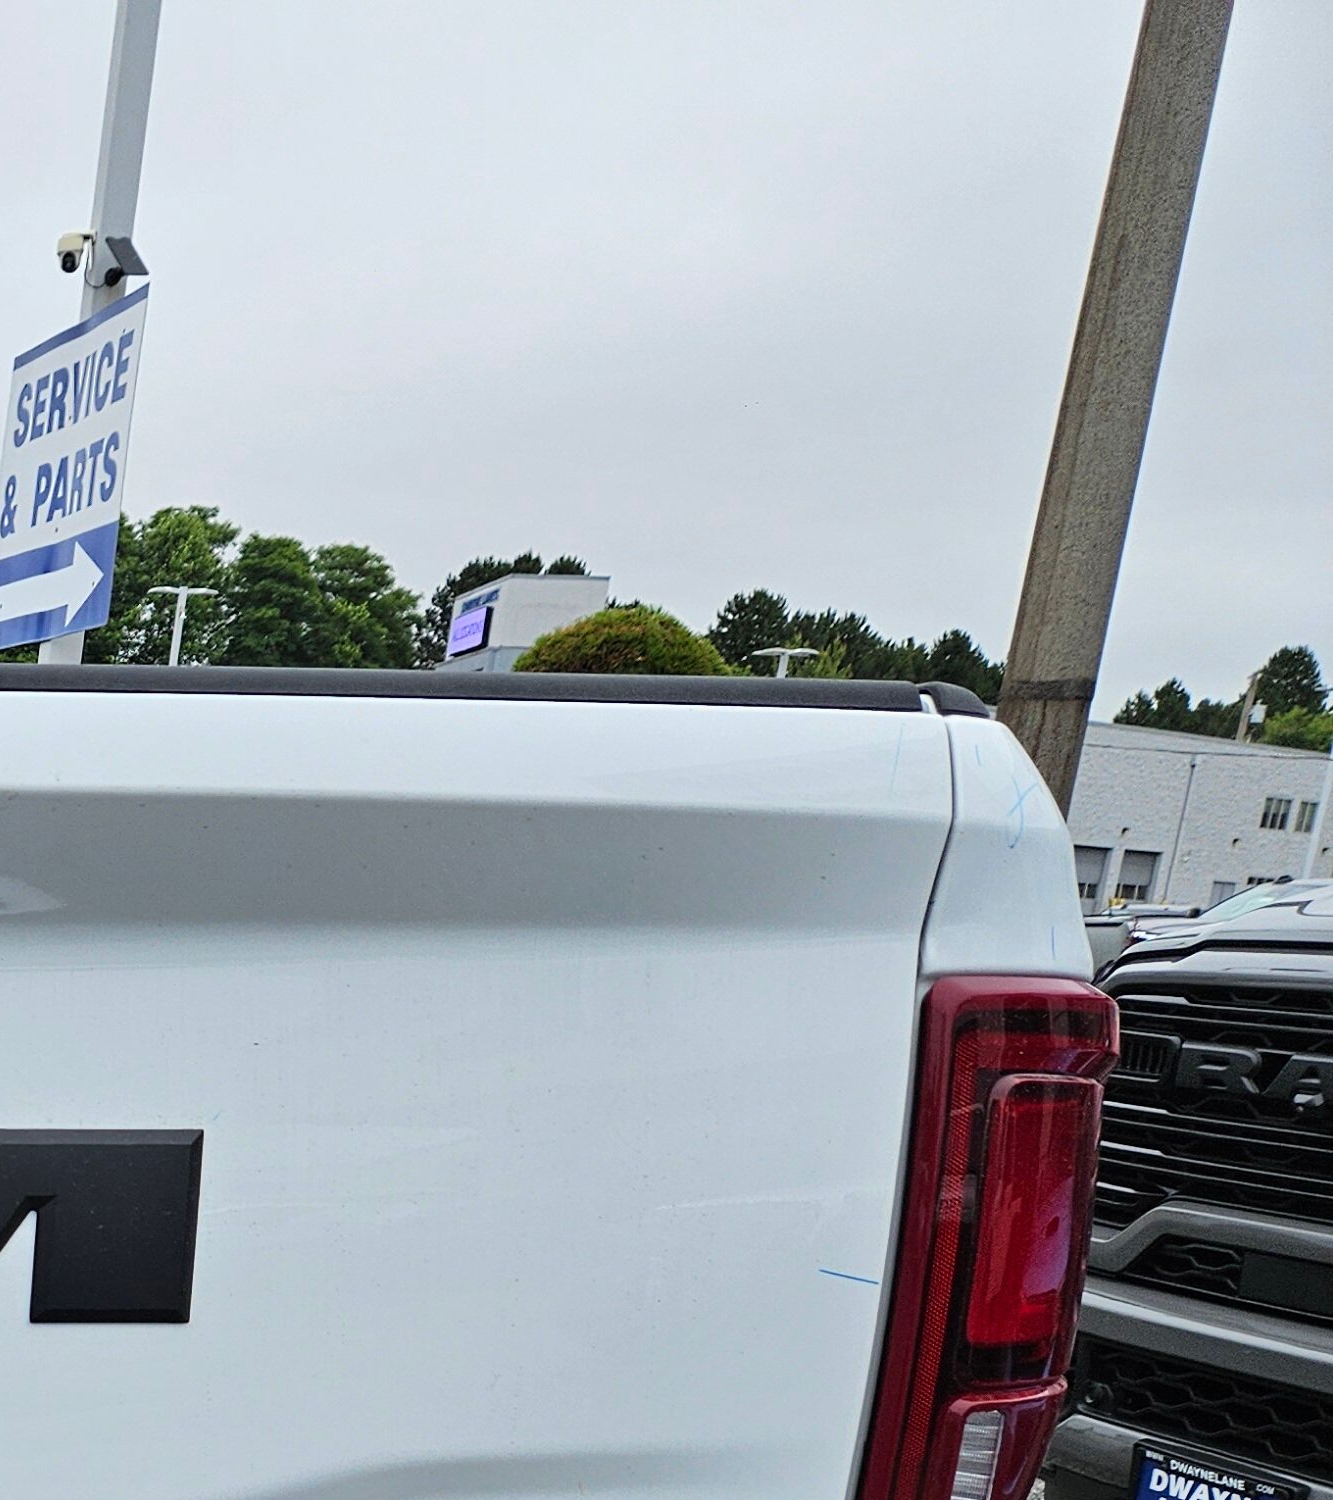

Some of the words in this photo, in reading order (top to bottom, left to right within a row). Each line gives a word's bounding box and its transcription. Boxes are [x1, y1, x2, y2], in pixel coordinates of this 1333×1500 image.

[13, 329, 135, 448] SERVICE
[0, 474, 18, 539] &
[30, 431, 120, 528] PARTS
[1169, 1459, 1246, 1491] DWAYNELANE
